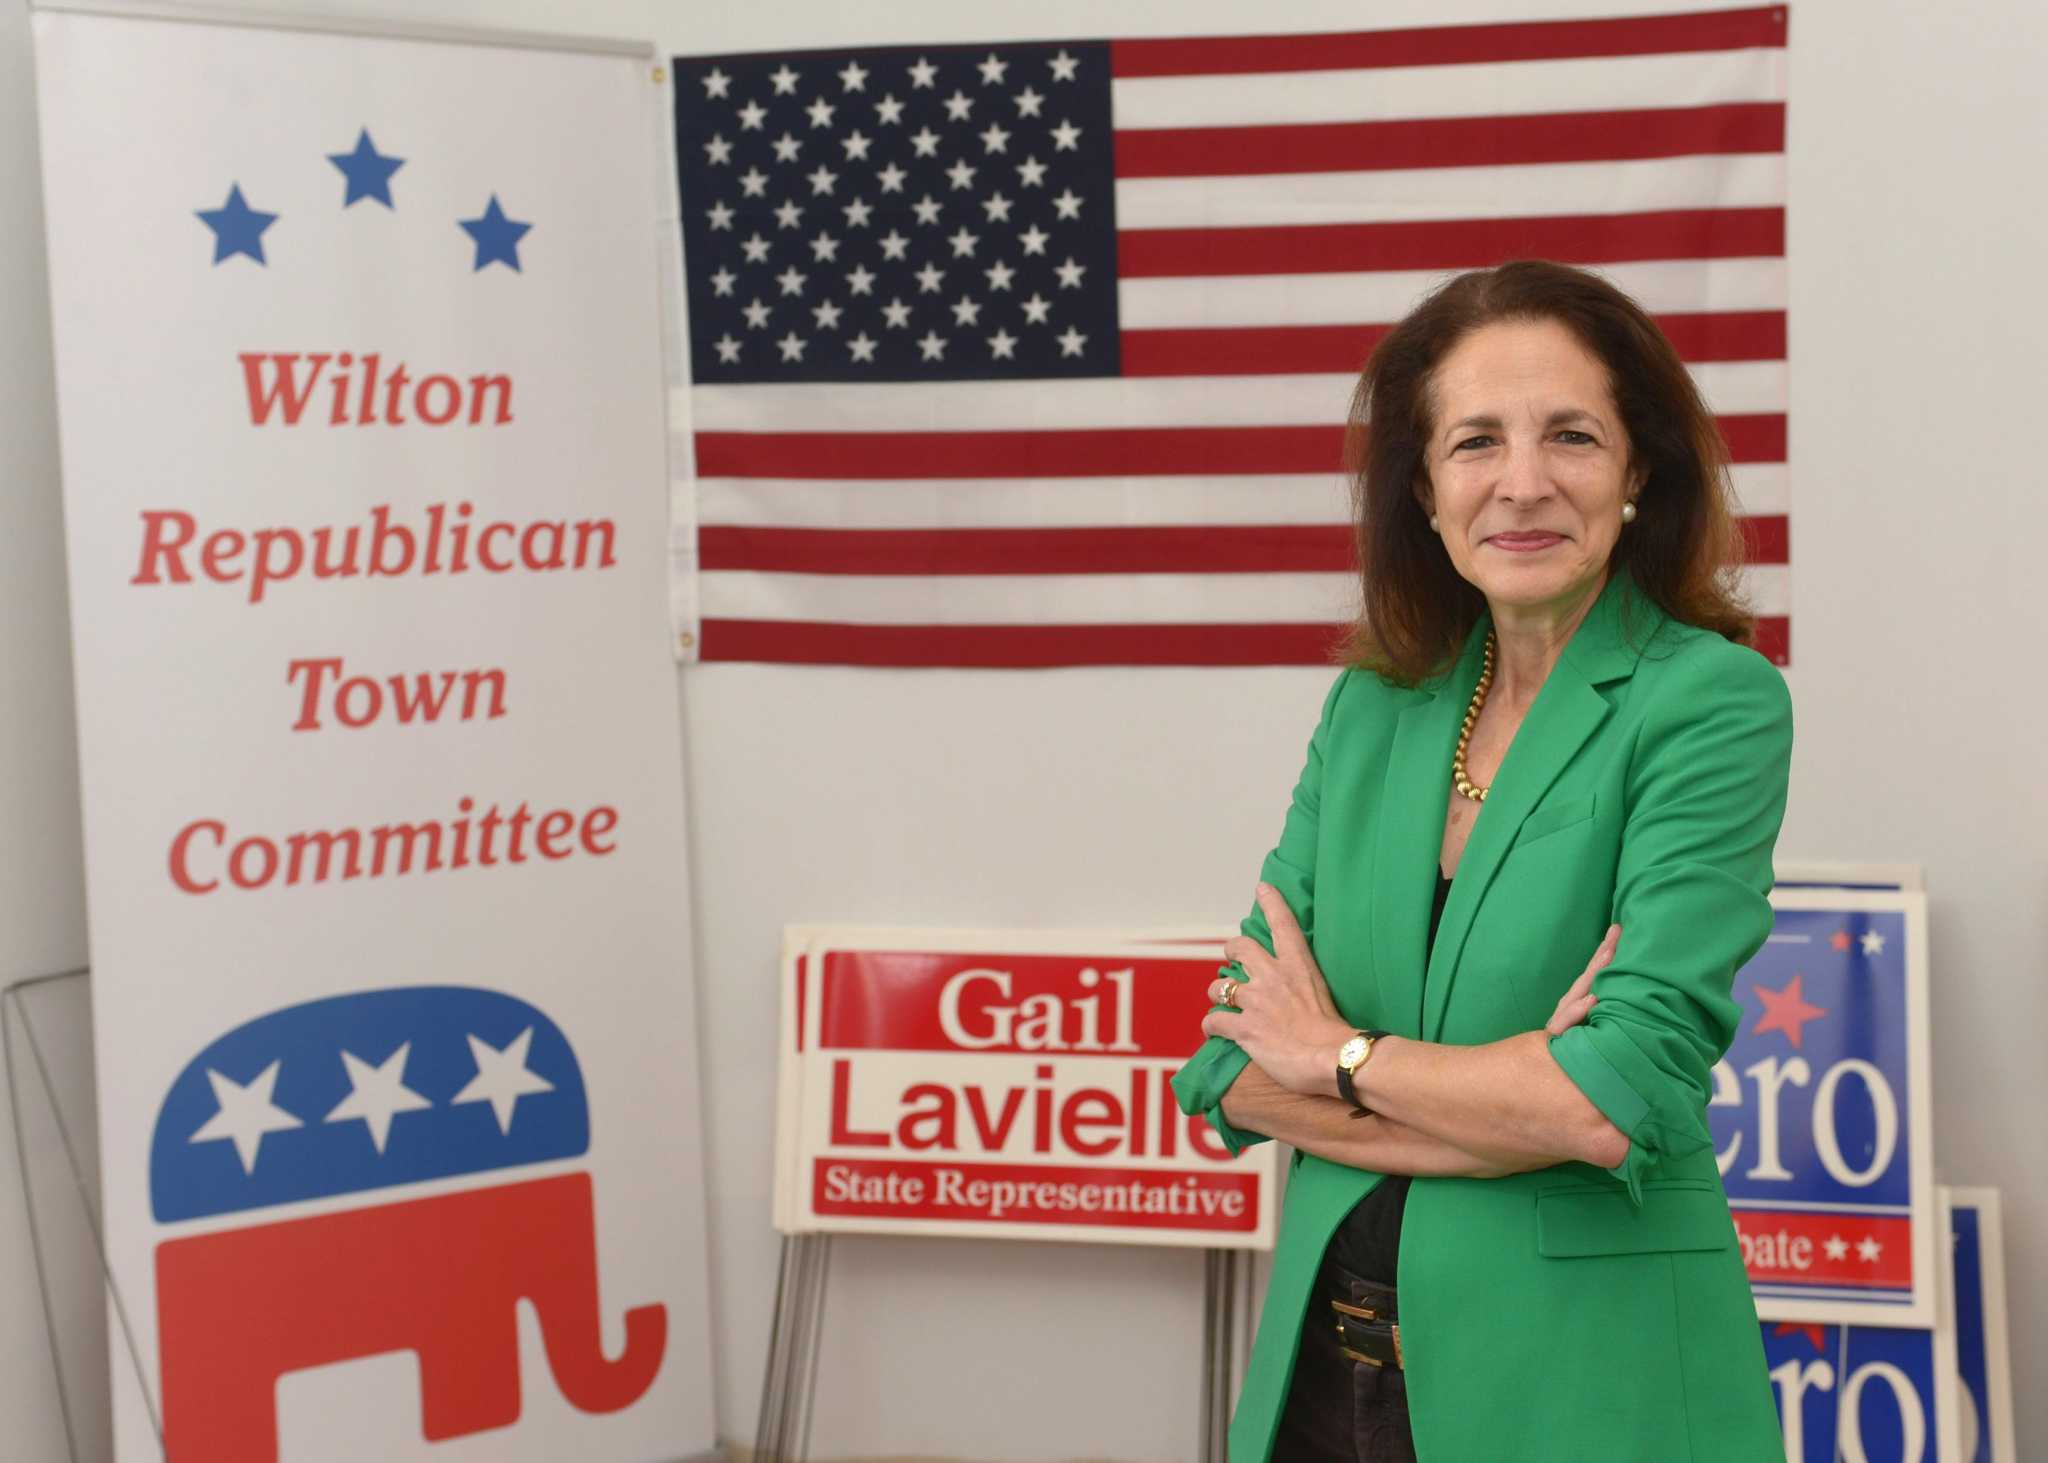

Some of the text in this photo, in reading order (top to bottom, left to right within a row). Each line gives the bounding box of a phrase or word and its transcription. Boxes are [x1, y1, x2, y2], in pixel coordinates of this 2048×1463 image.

[238, 352, 514, 427] Wilton
[131, 502, 617, 604] Republican
[287, 658, 507, 732] Town
[168, 797, 619, 896] Committee
[938, 967, 1140, 1052] Gail
[825, 1165, 1245, 1217] State Representative
